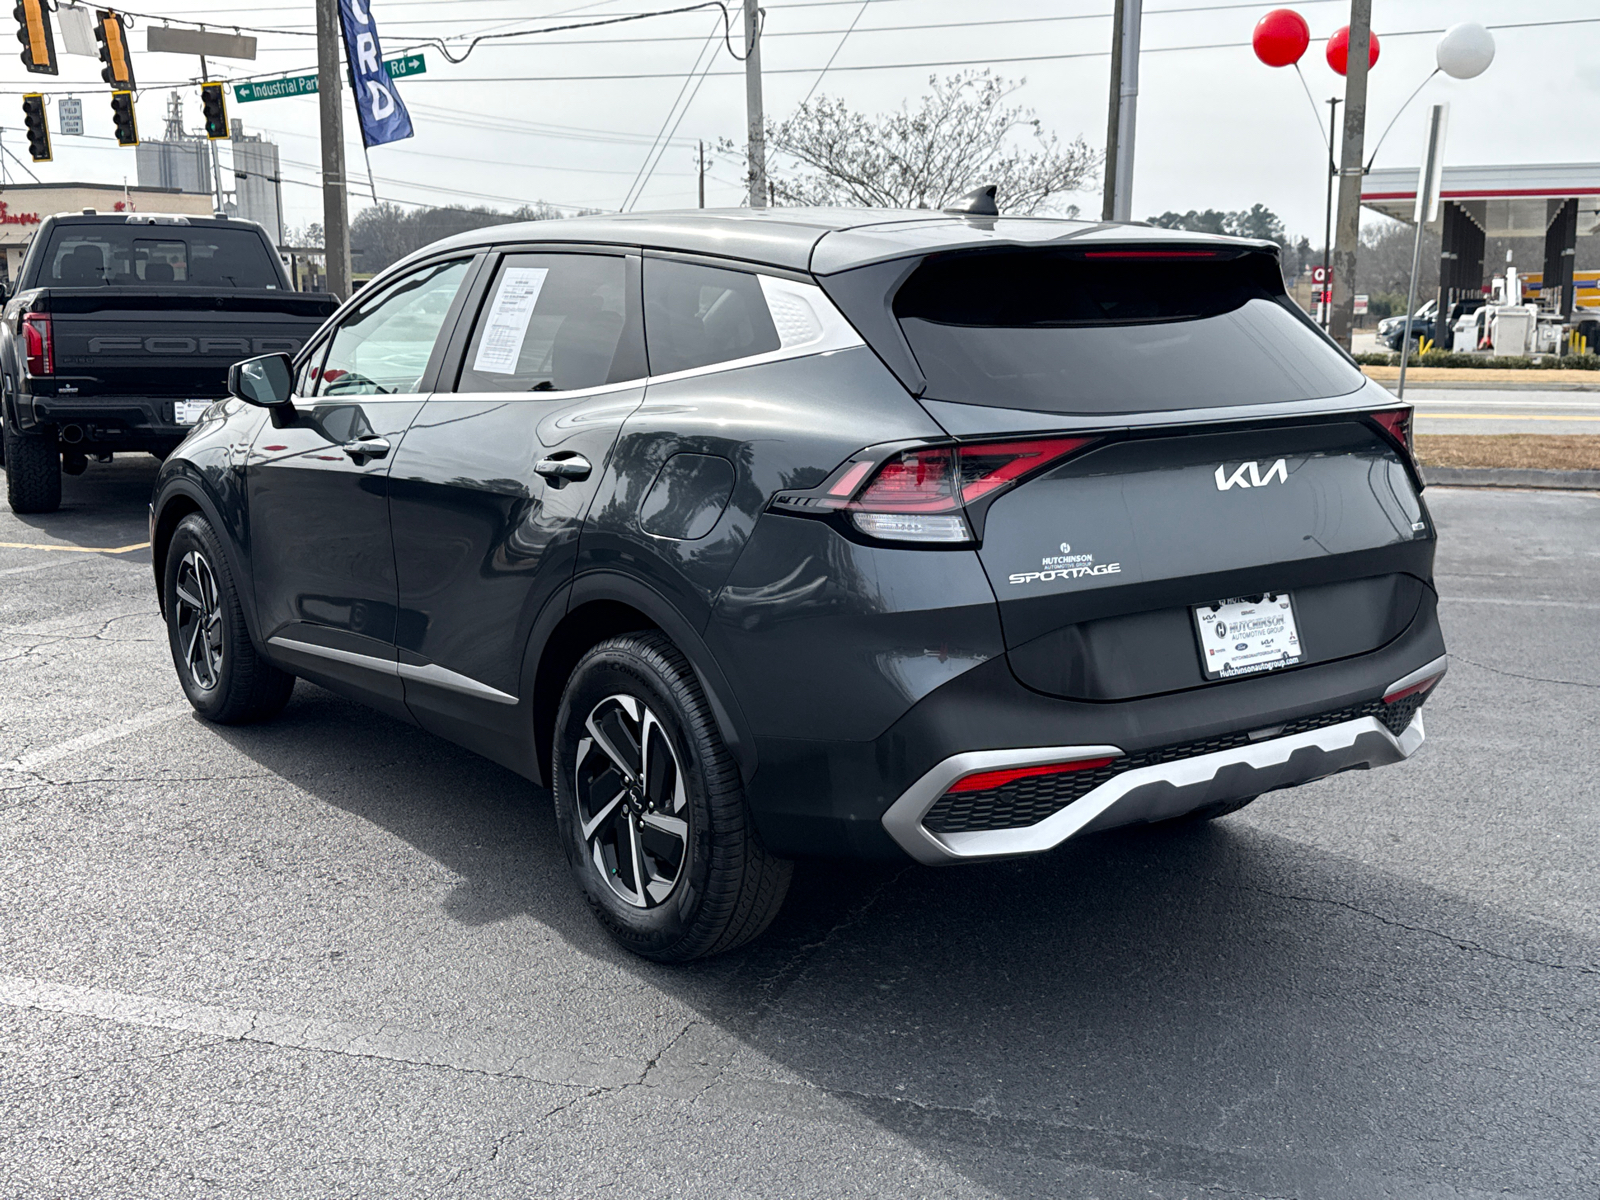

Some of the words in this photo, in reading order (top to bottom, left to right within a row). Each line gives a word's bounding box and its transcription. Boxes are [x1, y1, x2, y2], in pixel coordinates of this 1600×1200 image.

[252, 80, 297, 97] Industrial
[390, 60, 407, 76] Rd
[87, 336, 302, 353] FORD
[1214, 458, 1288, 491] KIA
[1042, 554, 1093, 566] HUTCHINSON
[1009, 563, 1122, 584] SPORTAGE
[1229, 614, 1285, 633] HUTCHINSON
[1231, 629, 1267, 641] AUTOMOTIVE
[1266, 626, 1285, 635] GROUP
